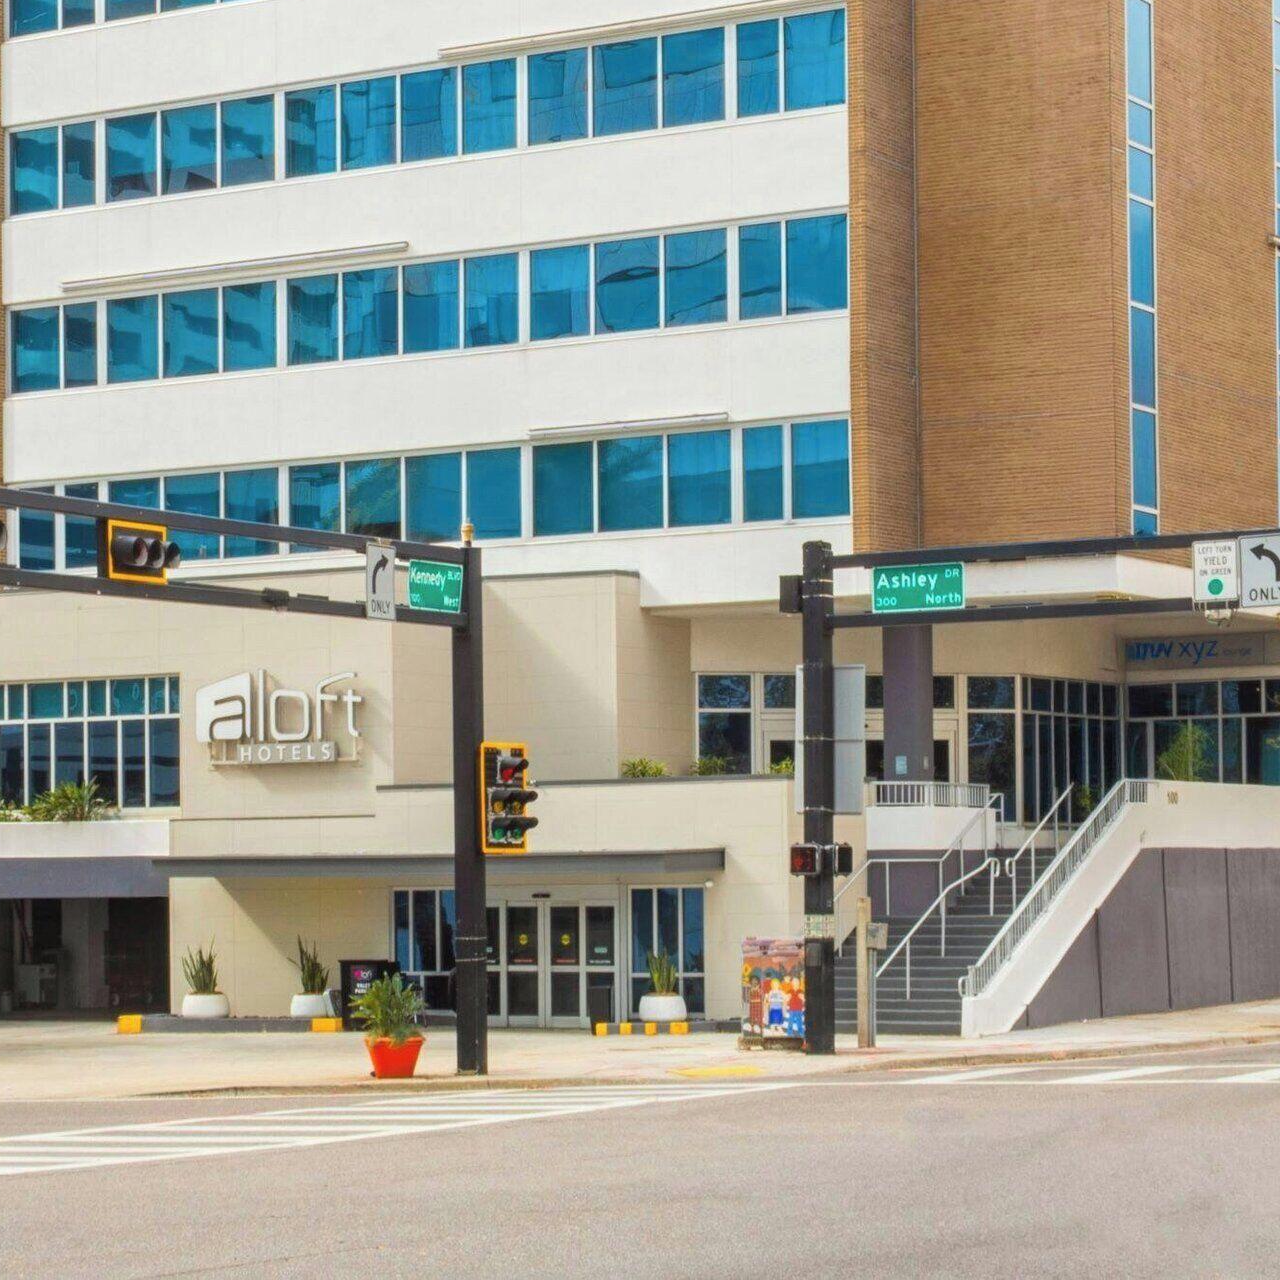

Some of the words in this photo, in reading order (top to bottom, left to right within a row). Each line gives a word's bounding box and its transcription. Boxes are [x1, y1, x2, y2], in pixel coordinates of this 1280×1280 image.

[1198, 547, 1213, 555] LEFT
[1216, 545, 1232, 553] TURN
[1203, 556, 1228, 566] YIELD
[410, 566, 447, 592] Kennedy
[1211, 567, 1232, 576] GREEN
[876, 571, 938, 591] Ashley
[944, 568, 960, 579] DR
[371, 599, 391, 615] ONLY
[443, 595, 459, 608] West
[876, 596, 897, 607] 300
[925, 592, 961, 605] North
[196, 669, 362, 743] aloft
[239, 742, 331, 762] HOTELS
